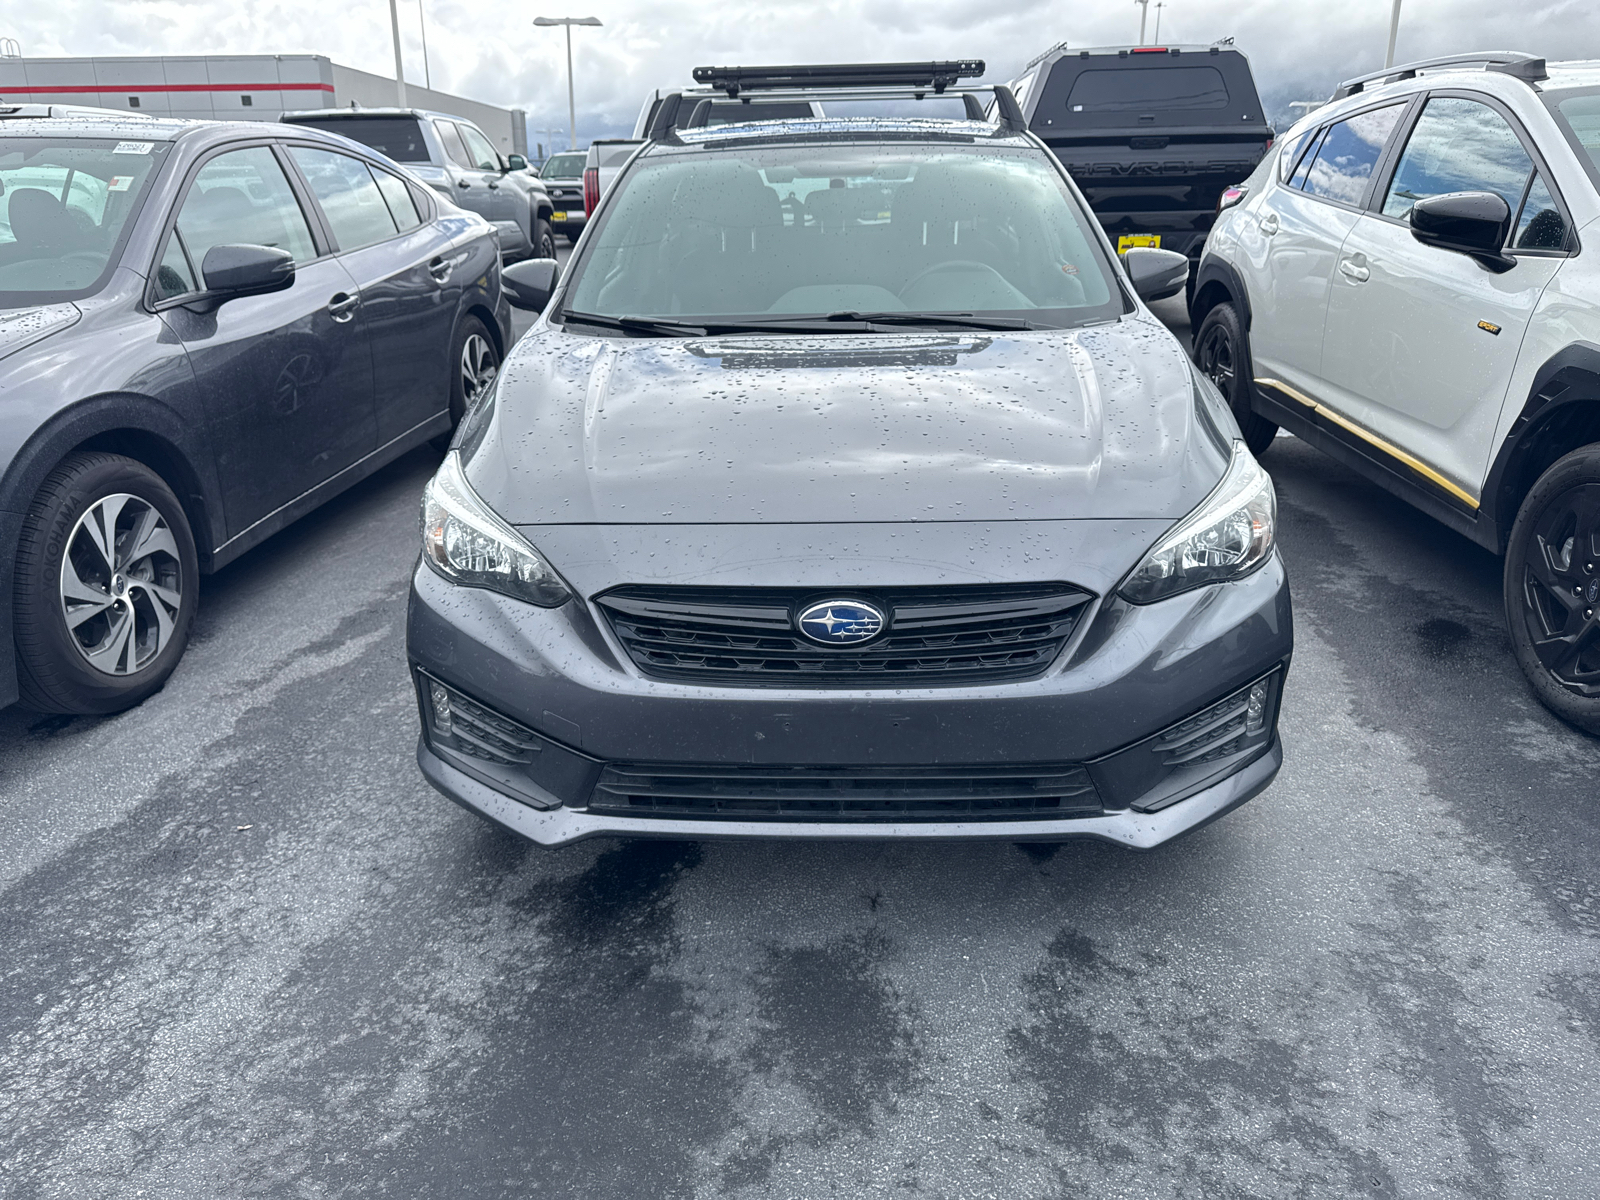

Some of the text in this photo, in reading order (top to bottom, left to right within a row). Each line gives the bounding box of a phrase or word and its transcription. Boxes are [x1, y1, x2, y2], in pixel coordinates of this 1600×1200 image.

[1063, 159, 1250, 176] HEVROLET
[1478, 321, 1499, 332] SPORT
[42, 495, 80, 592] YOKOHAMA
